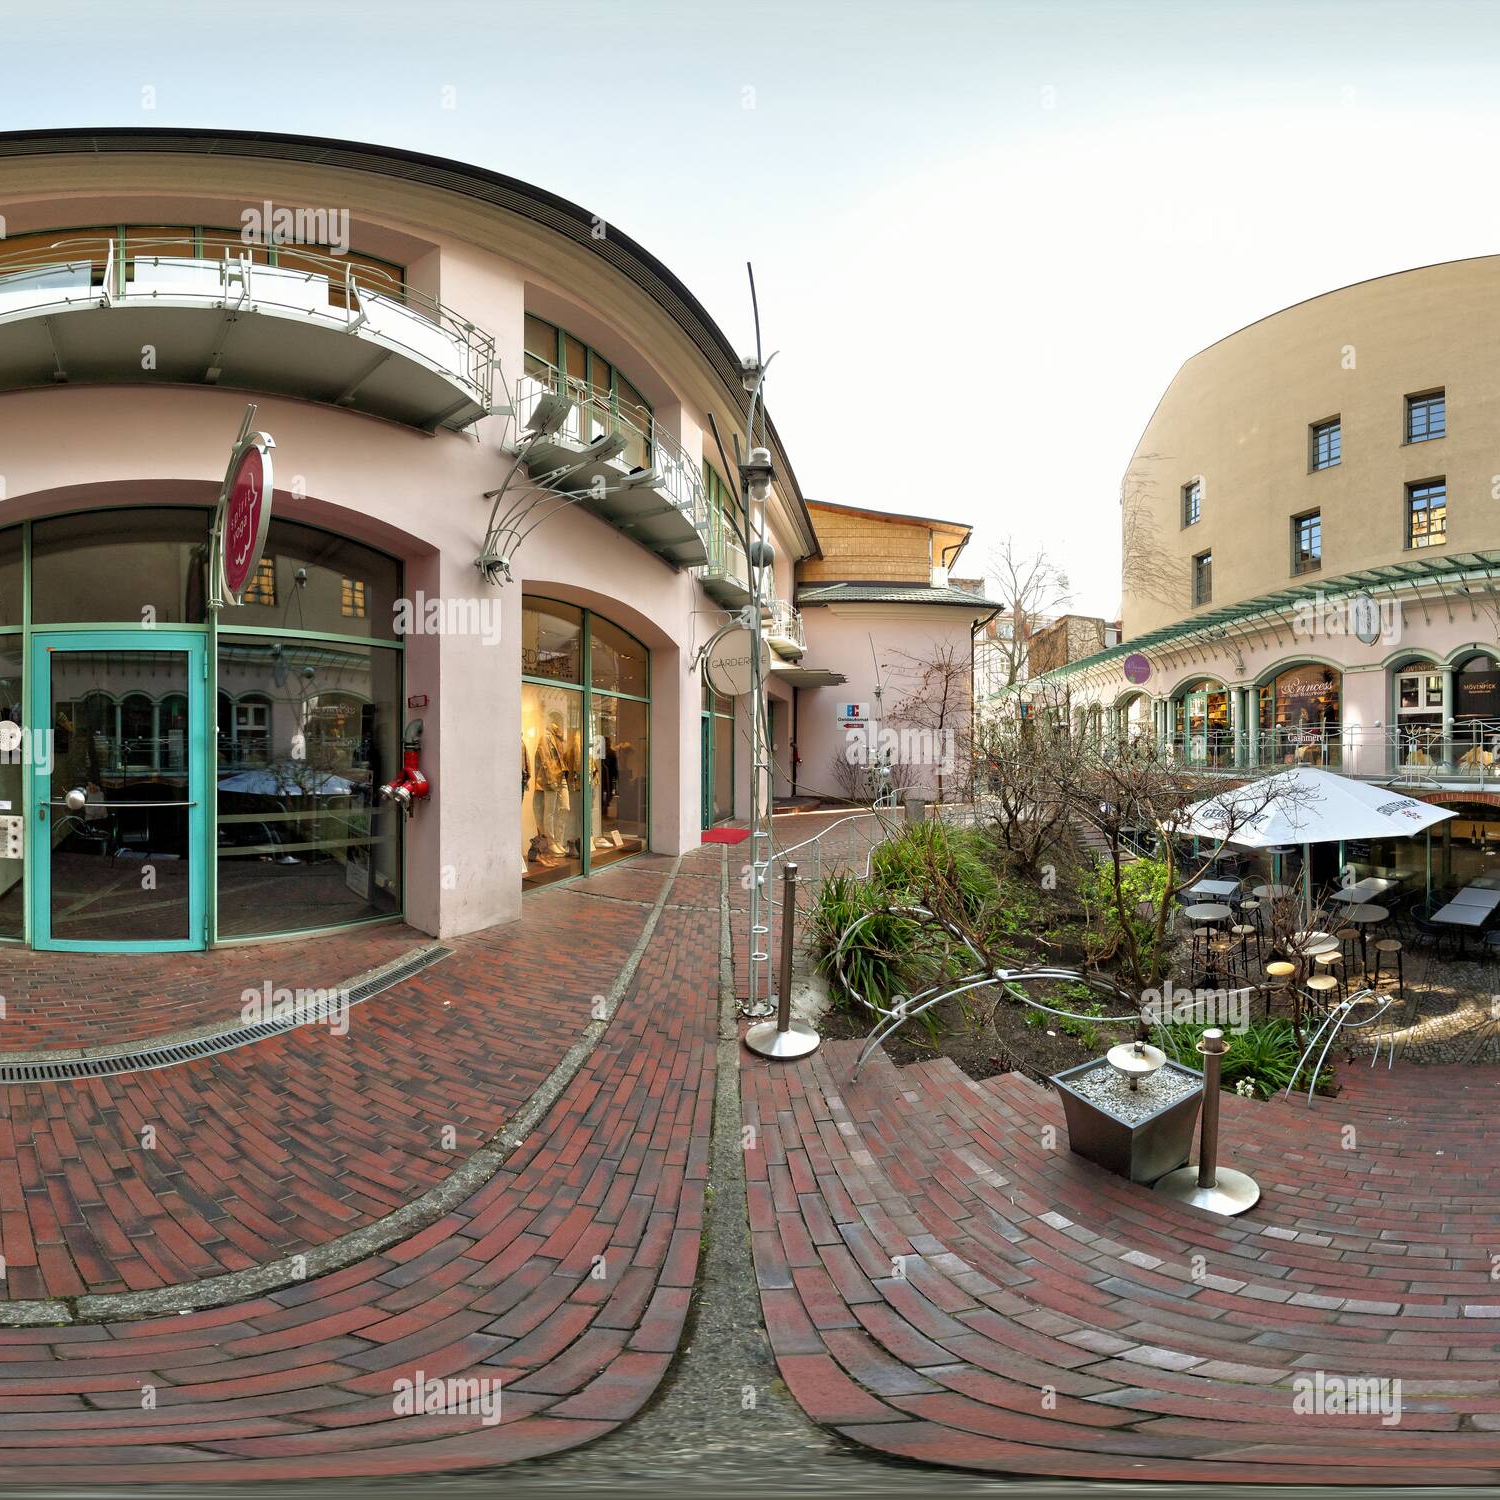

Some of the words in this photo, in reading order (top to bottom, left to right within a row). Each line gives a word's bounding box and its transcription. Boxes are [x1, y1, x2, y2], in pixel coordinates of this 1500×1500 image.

[233, 515, 247, 548] yoga
[1281, 677, 1332, 694] Princess
[847, 704, 859, 717] EC
